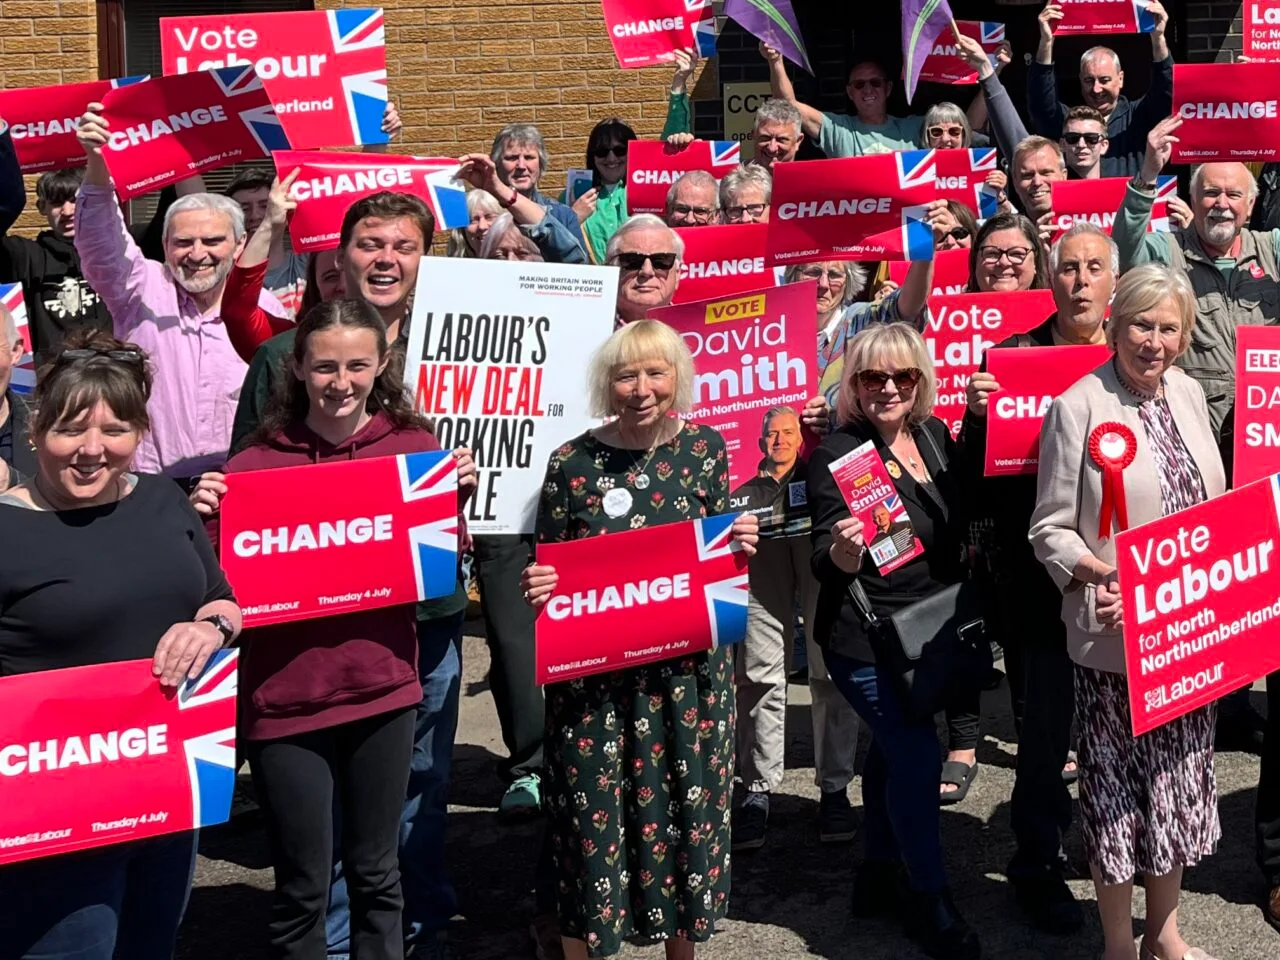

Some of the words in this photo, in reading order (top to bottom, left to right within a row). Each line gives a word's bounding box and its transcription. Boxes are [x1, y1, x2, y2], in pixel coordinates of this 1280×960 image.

[612, 16, 684, 38] CHANGE
[1251, 28, 1267, 39] for
[174, 27, 258, 51] Vote
[1179, 100, 1278, 119] CHANGE
[10, 117, 82, 139] CHAN
[107, 105, 228, 152] CHANGE
[187, 155, 222, 171] Thursday
[1230, 149, 1257, 157] Thursday
[289, 168, 413, 200] CHANGE
[632, 169, 684, 184] CHAN
[935, 176, 967, 189] NGE
[777, 198, 892, 221] CHANGE
[832, 245, 864, 254] Thursday
[712, 299, 760, 319] VOTE
[928, 305, 1002, 332] Vote
[421, 312, 550, 365] LABOUR'S
[926, 335, 995, 367] Lab
[693, 351, 808, 405] mith
[935, 377, 950, 389] or
[416, 363, 478, 414] NEW
[482, 366, 544, 417] DEAL
[548, 403, 565, 417] FOR
[678, 407, 711, 420] North
[712, 390, 808, 416] Northumberland
[996, 396, 1054, 419] CHA
[850, 483, 892, 512] Smith
[851, 476, 882, 498] David
[730, 495, 750, 508] our
[233, 514, 394, 558] CHANGE
[1129, 524, 1211, 576] Vote
[1134, 538, 1275, 625] Labour
[242, 605, 260, 615] ote
[266, 599, 300, 611] Labour
[318, 591, 362, 607] Thursday
[371, 587, 392, 599] July
[546, 573, 691, 621] CHANGE
[1138, 630, 1163, 654] for
[1166, 607, 1216, 642] North
[623, 645, 664, 659] Thursday
[672, 639, 689, 651] July
[547, 662, 570, 673] Vote
[578, 654, 607, 669] Labour
[1161, 661, 1225, 706] Labour
[0, 724, 168, 776] CHANGE
[91, 818, 138, 833] Thursday
[147, 810, 168, 823] July
[35, 827, 73, 842] Labour
